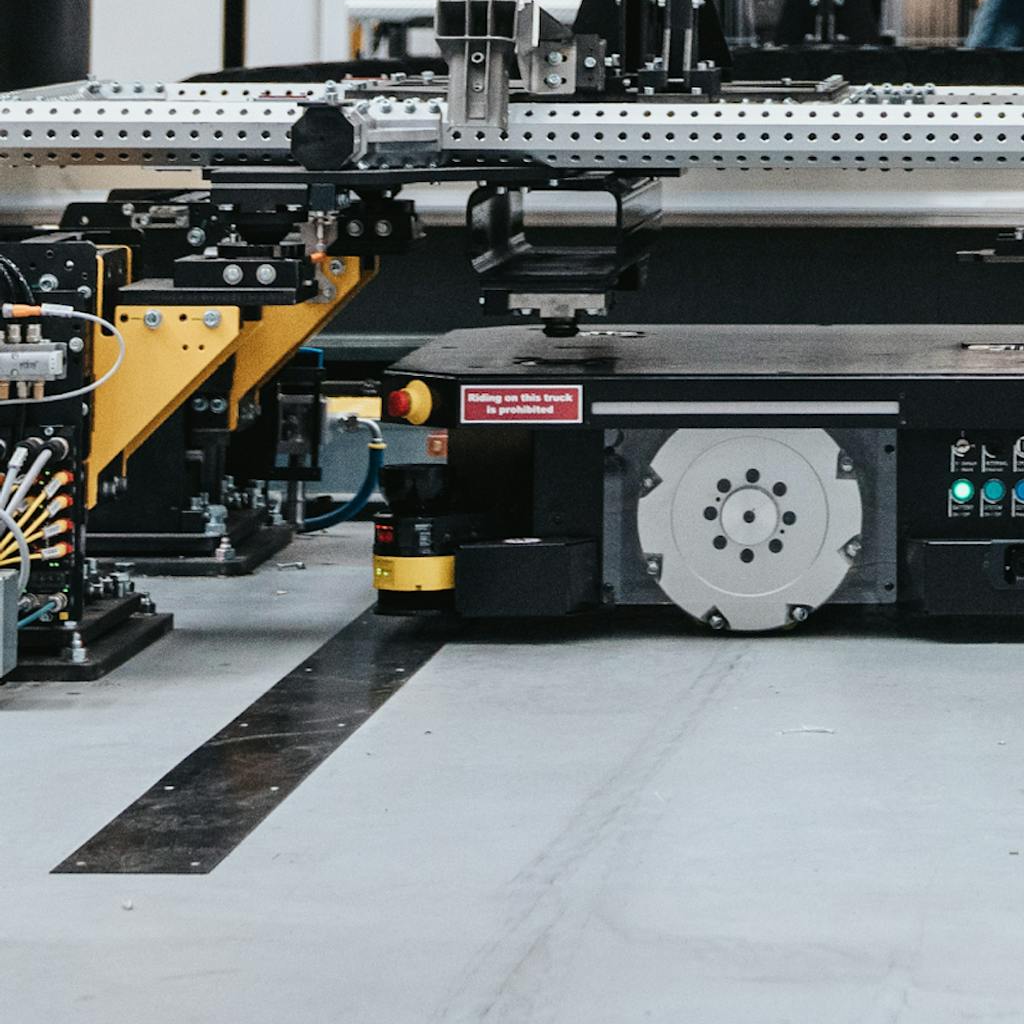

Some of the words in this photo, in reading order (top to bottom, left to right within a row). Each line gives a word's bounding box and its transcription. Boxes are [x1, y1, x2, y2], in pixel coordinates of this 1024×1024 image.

[468, 393, 502, 404] Riding
[521, 393, 541, 402] this
[544, 393, 573, 402] truck
[486, 405, 496, 414] is
[499, 405, 554, 416] prohibited
